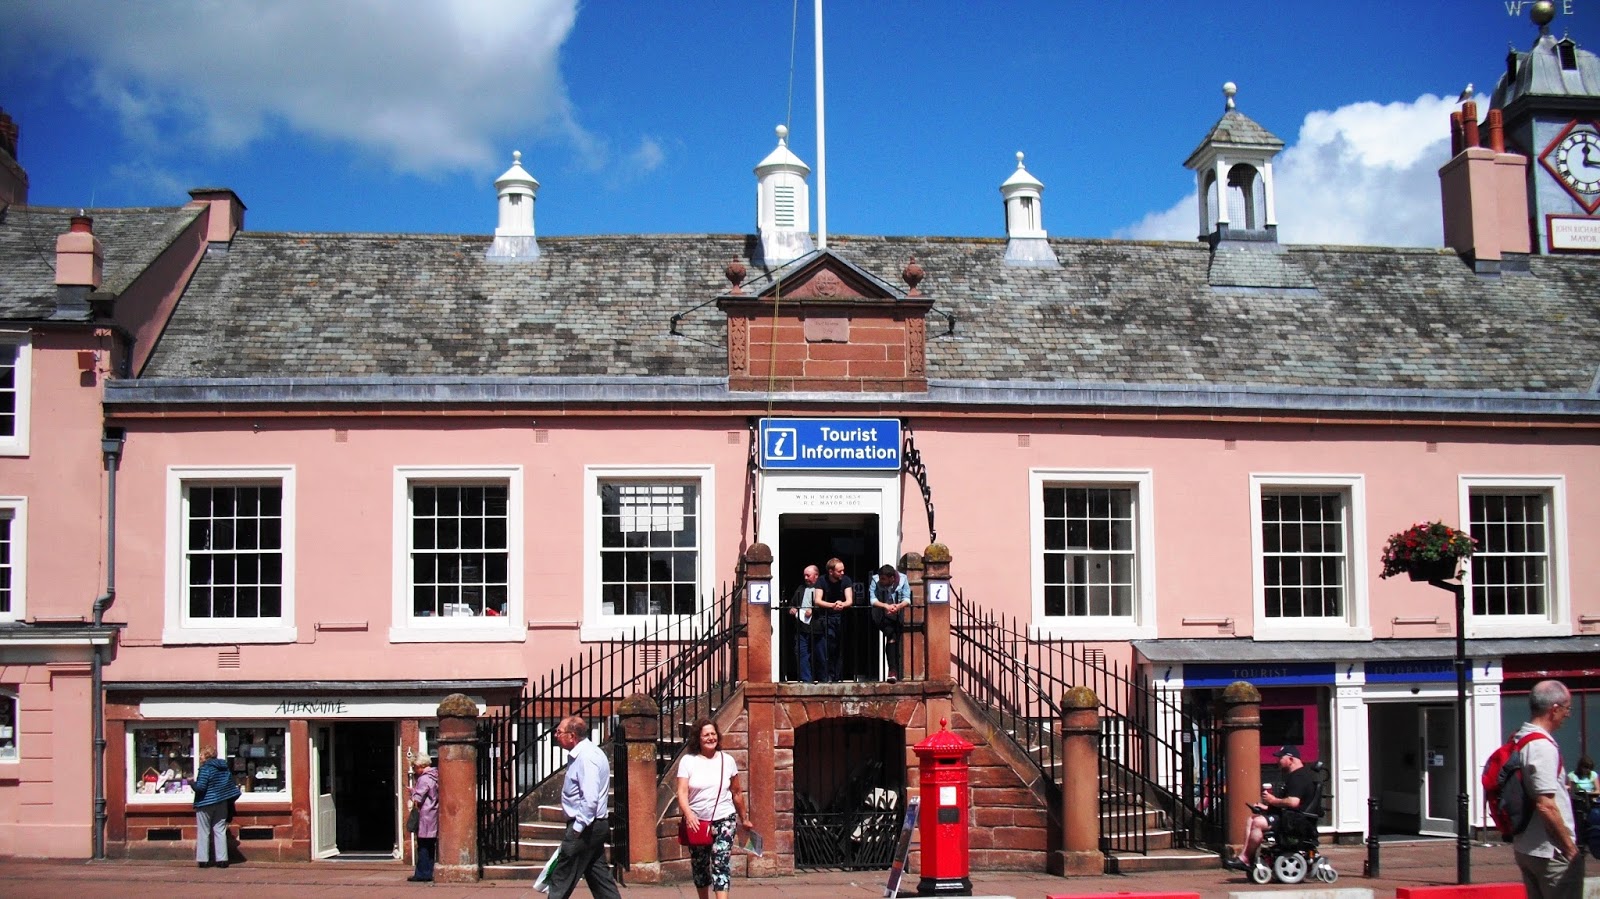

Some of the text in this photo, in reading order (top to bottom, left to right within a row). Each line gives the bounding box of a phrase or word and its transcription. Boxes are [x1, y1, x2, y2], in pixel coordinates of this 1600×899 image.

[1570, 235, 1597, 243] MAYOR
[820, 427, 877, 442] Tourist
[801, 444, 896, 459] Information
[1231, 667, 1288, 679] TOURIST
[1374, 665, 1457, 674] INFORMATIO
[274, 698, 348, 715] ALTERNATIVE
